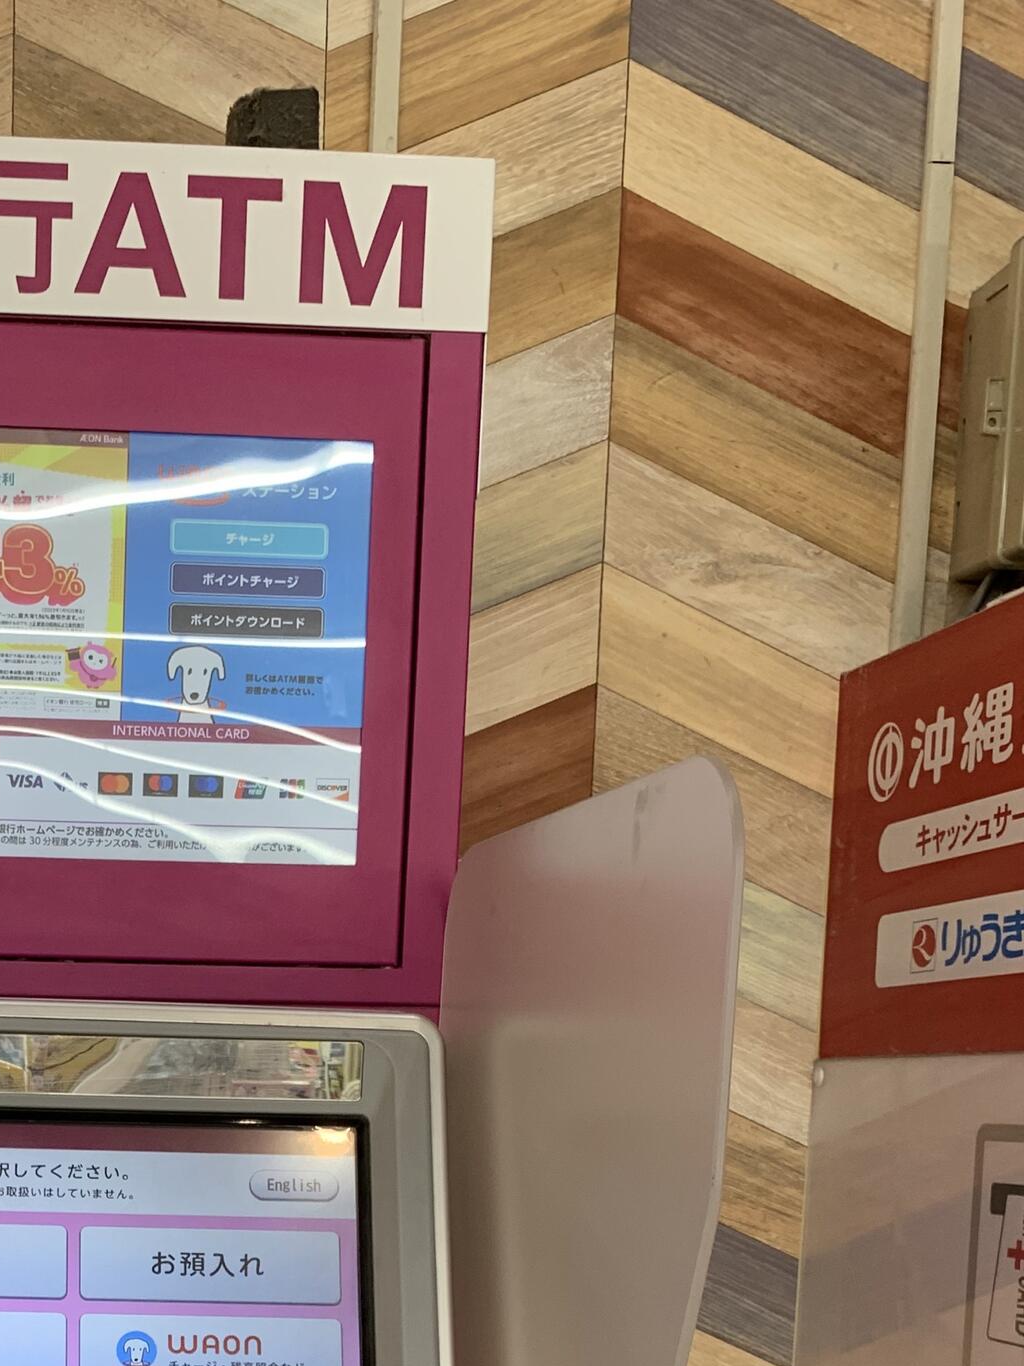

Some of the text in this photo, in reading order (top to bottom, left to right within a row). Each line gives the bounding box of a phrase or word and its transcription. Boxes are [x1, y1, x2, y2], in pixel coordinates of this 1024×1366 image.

[225, 533, 275, 546] チャージ
[202, 573, 300, 589] ポイントチャージ
[190, 614, 306, 630] ポイントダウンロード
[112, 725, 250, 740] INTERNATIONAL CARD
[907, 681, 1015, 789] 沖縄
[6, 773, 44, 789] VISA
[266, 1176, 322, 1195] English
[151, 1250, 265, 1278] お預入れ
[167, 1333, 262, 1356] WAON
